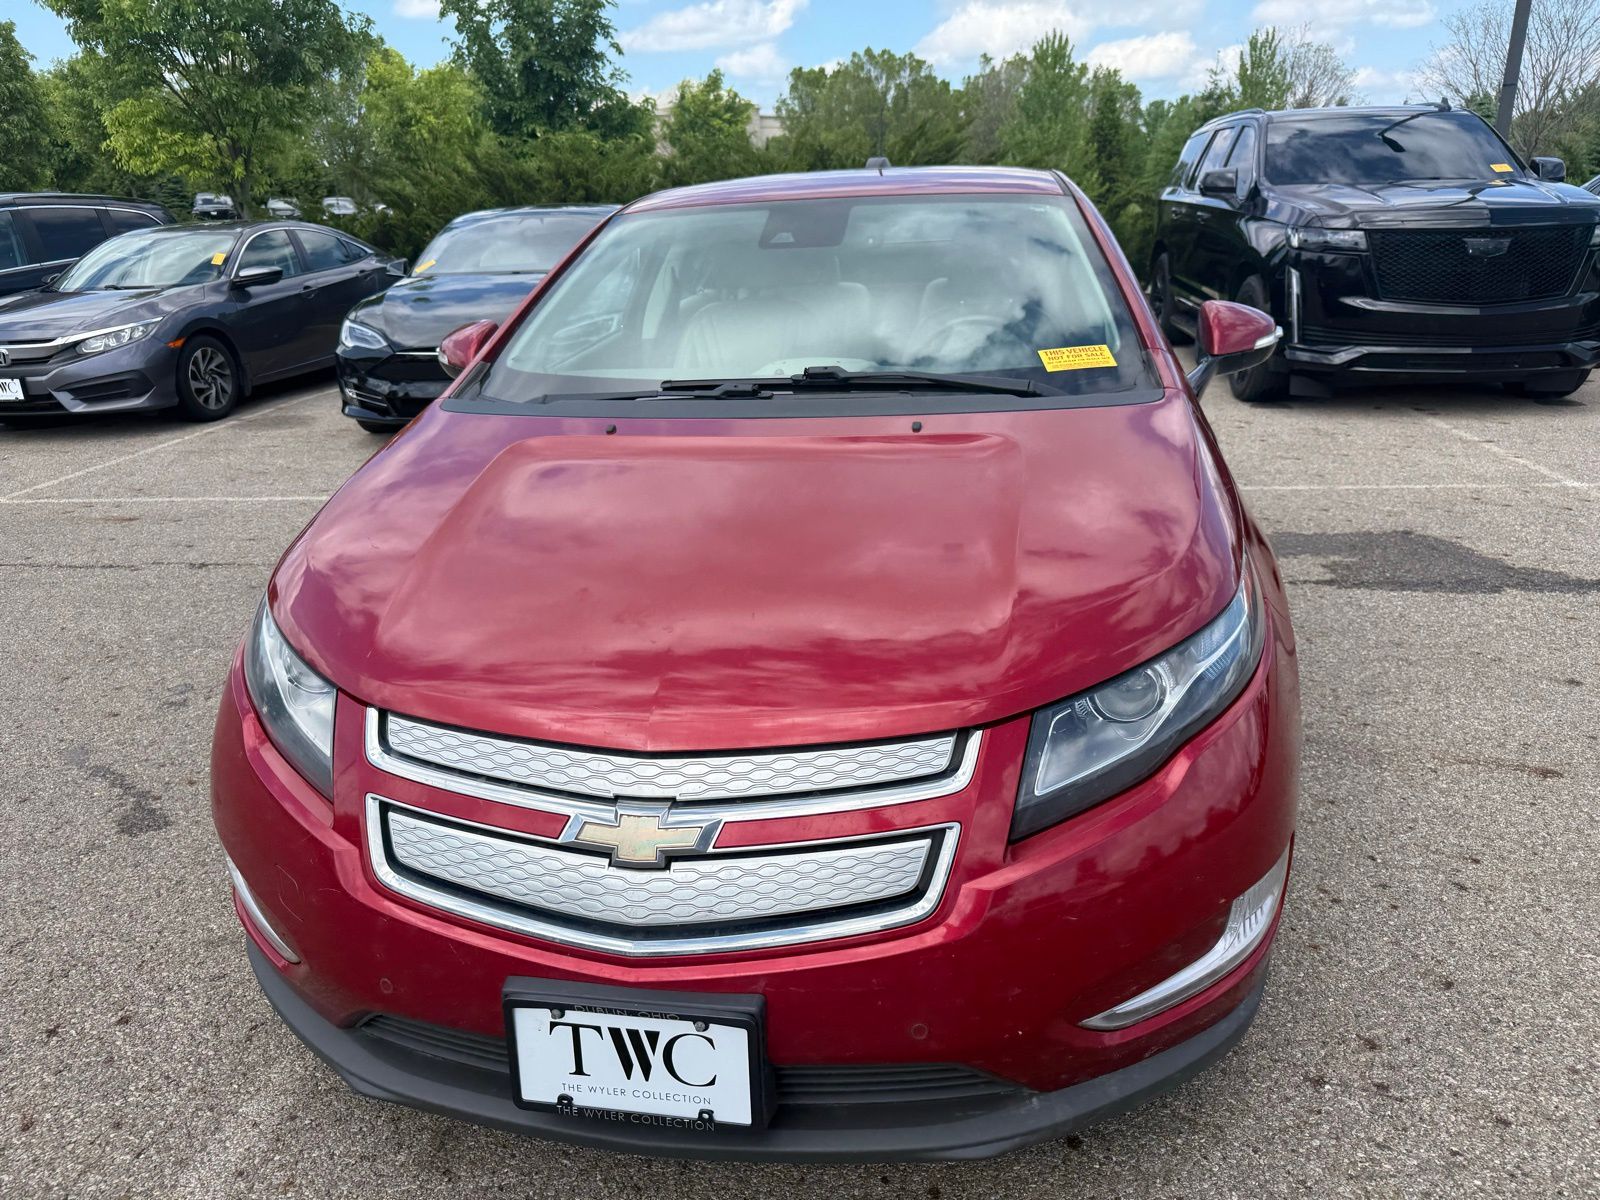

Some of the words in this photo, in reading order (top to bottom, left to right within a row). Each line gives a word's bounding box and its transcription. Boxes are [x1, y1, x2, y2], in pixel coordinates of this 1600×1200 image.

[1066, 346, 1105, 354] VEHICLE
[549, 1021, 717, 1087] TWC
[562, 1082, 583, 1093] THE
[588, 1085, 627, 1097] WYLER
[632, 1089, 712, 1105] COLLECTION
[556, 1105, 579, 1117] THE
[584, 1108, 625, 1122] WYLER
[630, 1114, 715, 1131] COLLECTION
